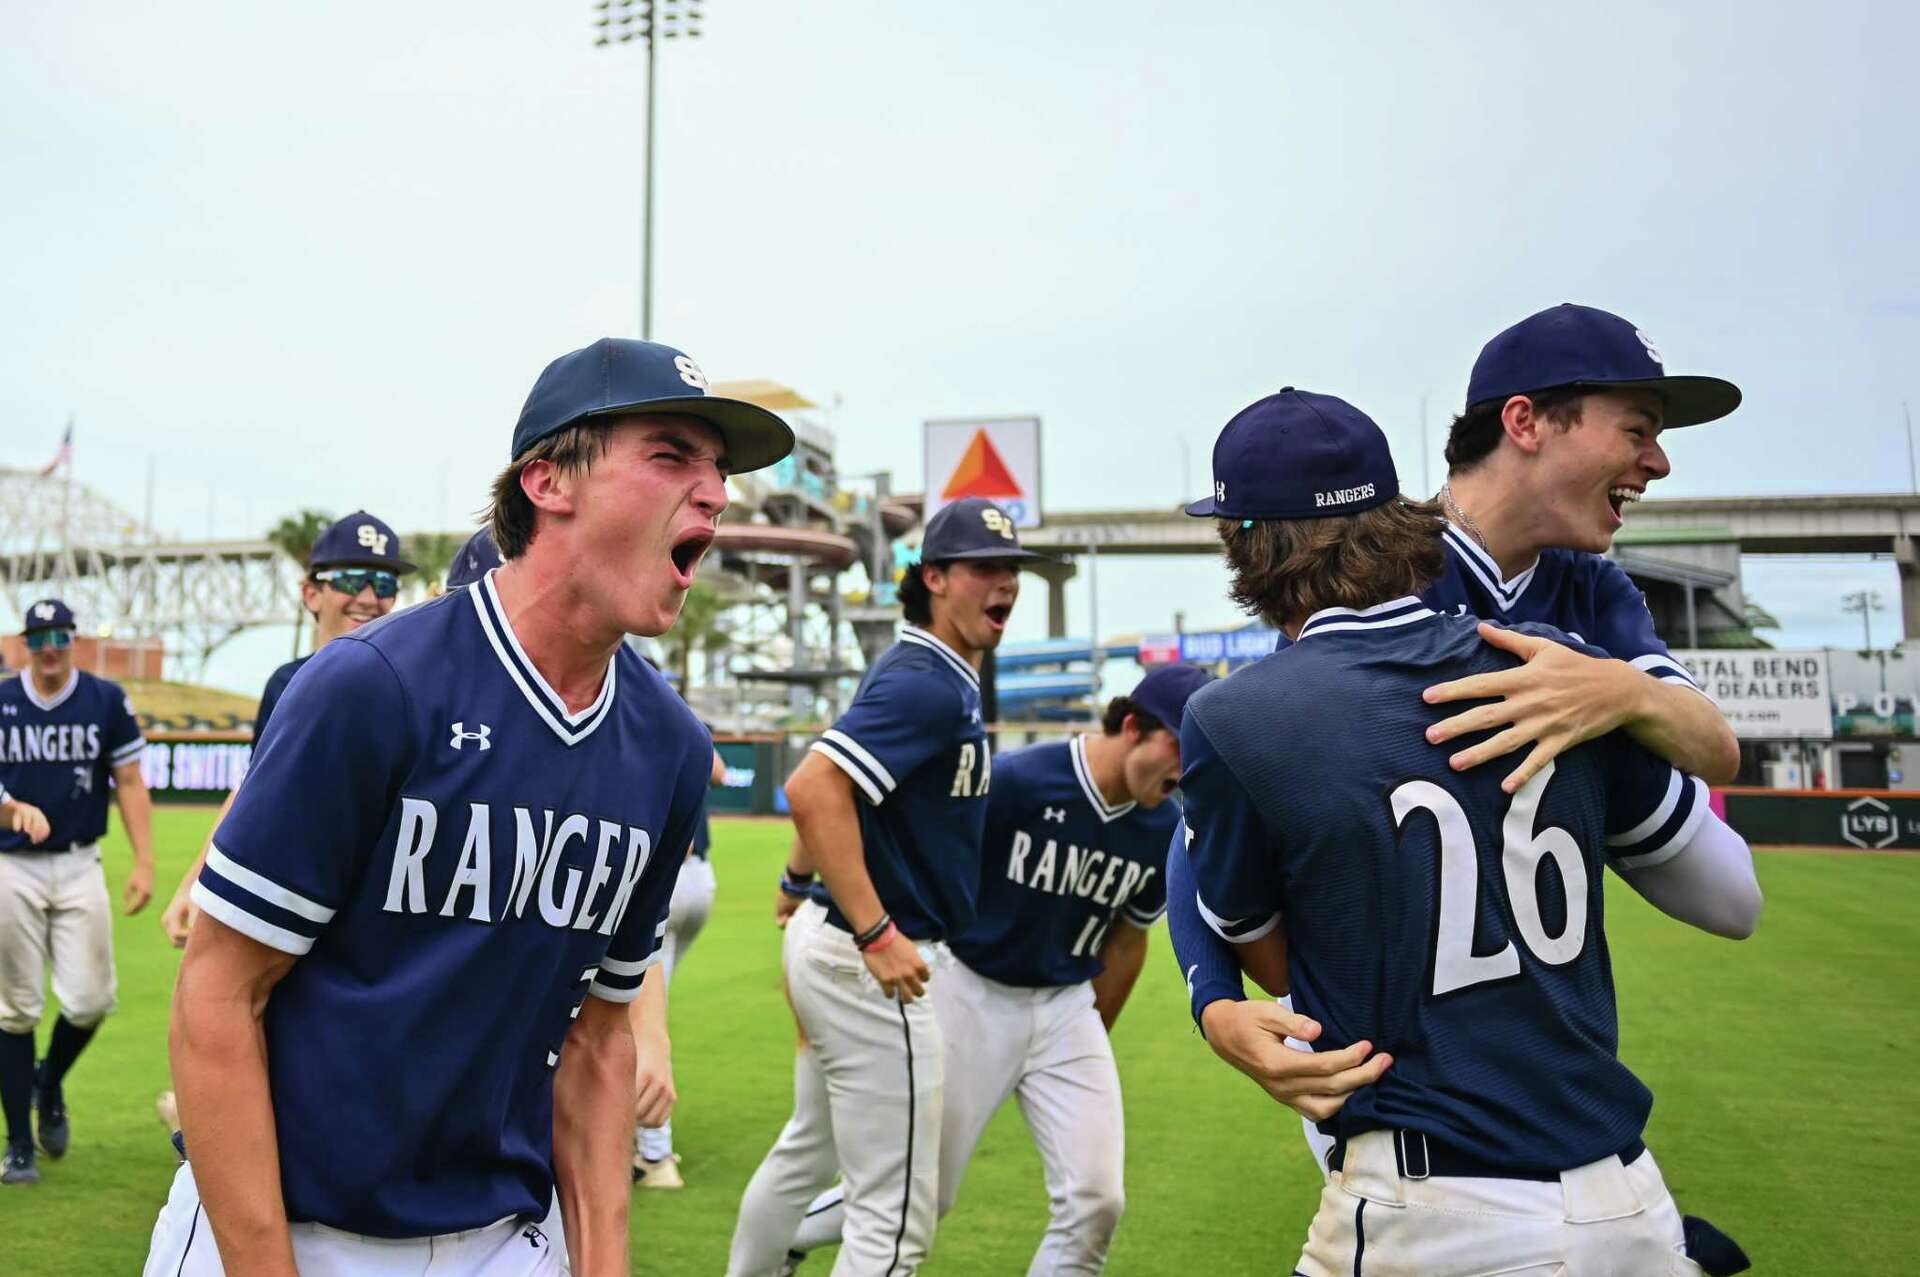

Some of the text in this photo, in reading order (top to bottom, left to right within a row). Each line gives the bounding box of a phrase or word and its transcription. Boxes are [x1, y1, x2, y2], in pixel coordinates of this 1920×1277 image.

[1314, 483, 1376, 507] RANGERS
[1753, 657, 1819, 678] BEND
[1717, 681, 1820, 699] DEALERS
[1851, 814, 1889, 833] LYB
[1390, 758, 1589, 996] 26
